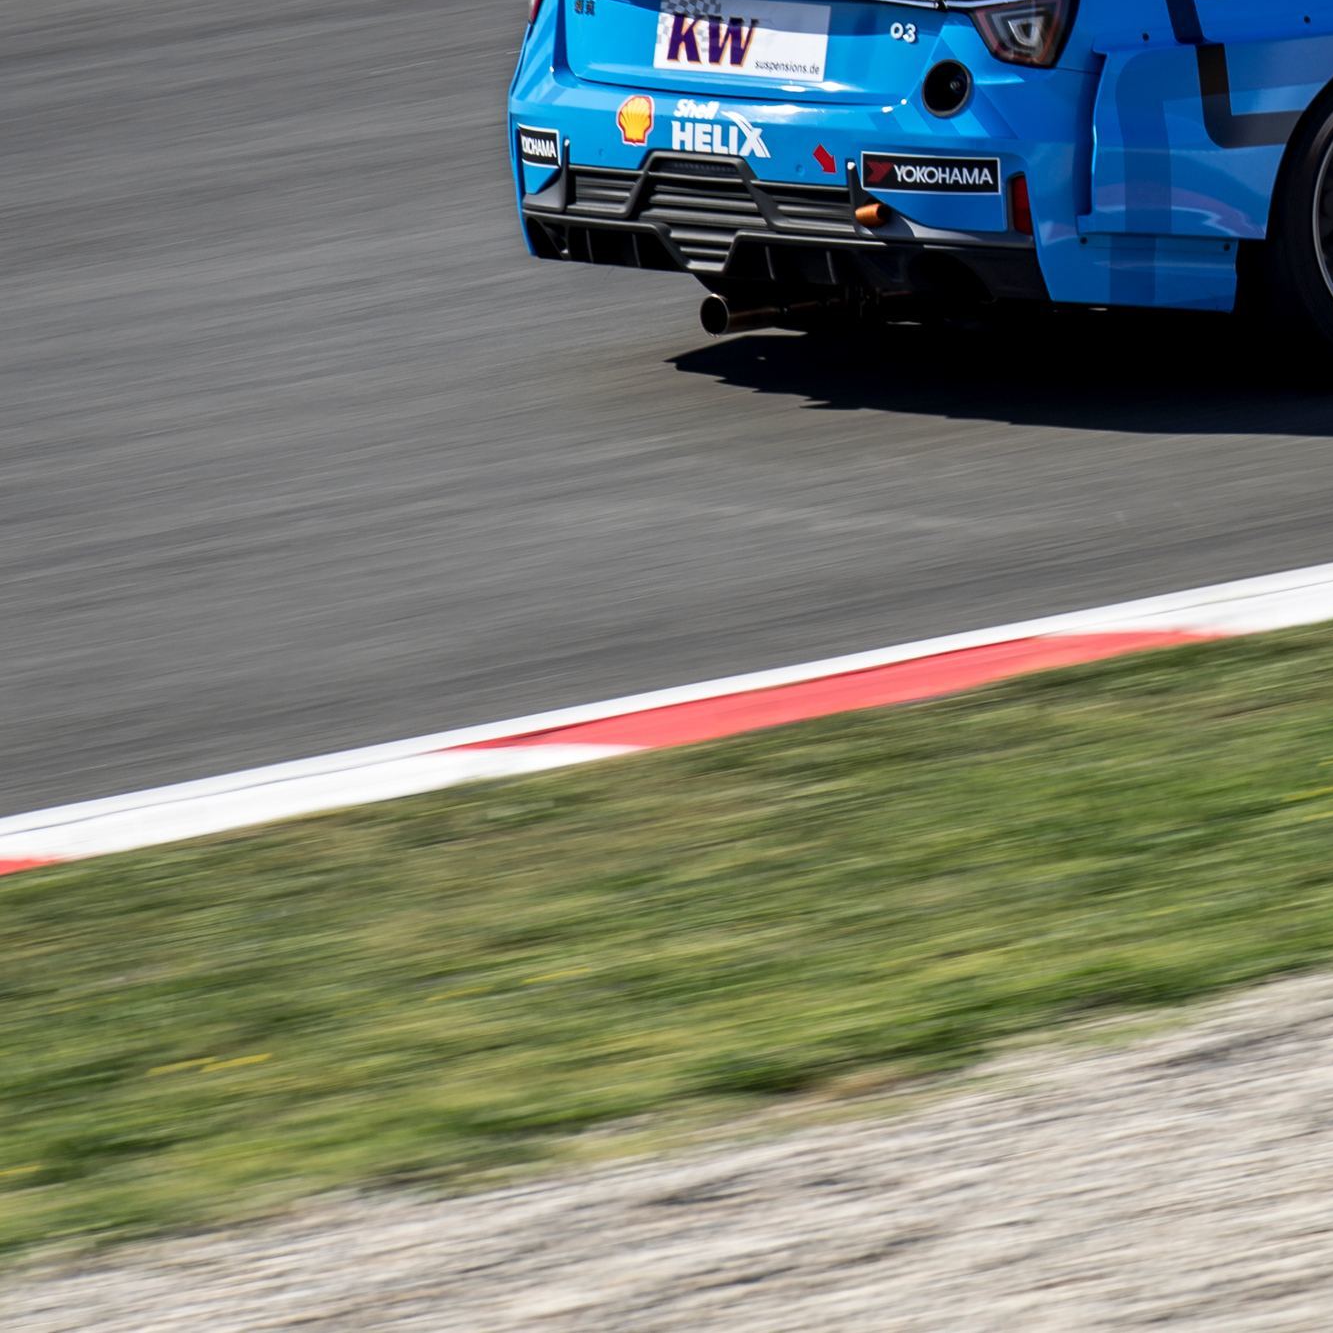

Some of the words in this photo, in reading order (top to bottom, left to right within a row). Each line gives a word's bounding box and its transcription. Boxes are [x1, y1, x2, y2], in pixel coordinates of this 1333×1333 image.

[666, 12, 760, 66] KW
[753, 58, 821, 76] suspensions.de
[674, 98, 721, 120] Shell
[671, 116, 771, 159] HELIX
[893, 164, 994, 185] YOKOHAMA
